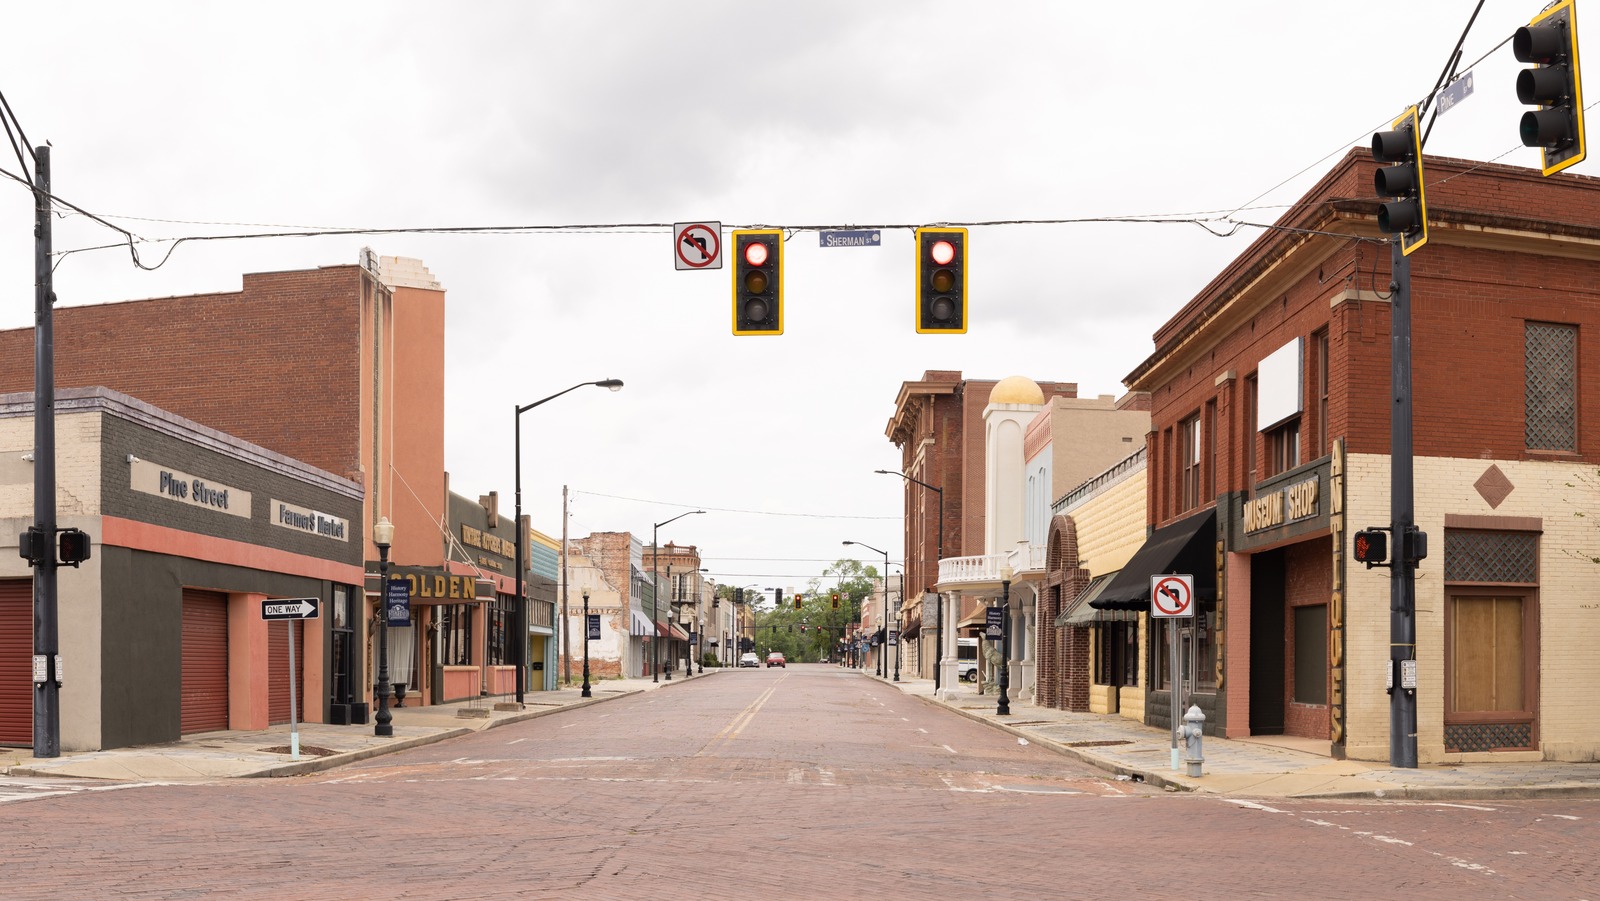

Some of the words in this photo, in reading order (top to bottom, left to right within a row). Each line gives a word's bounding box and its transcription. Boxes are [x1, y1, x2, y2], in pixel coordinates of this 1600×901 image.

[1440, 93, 1454, 112] PINE
[826, 234, 865, 247] SHERMAN
[160, 470, 187, 499] Pine
[191, 479, 229, 509] Street
[1243, 490, 1283, 534] MUSEUM
[1288, 479, 1317, 520] SHOP
[317, 515, 344, 539] Market
[391, 573, 476, 599] OLDEN
[1329, 439, 1343, 744] ANTIQUES
[267, 605, 283, 614] ONE
[285, 604, 301, 613] WAY
